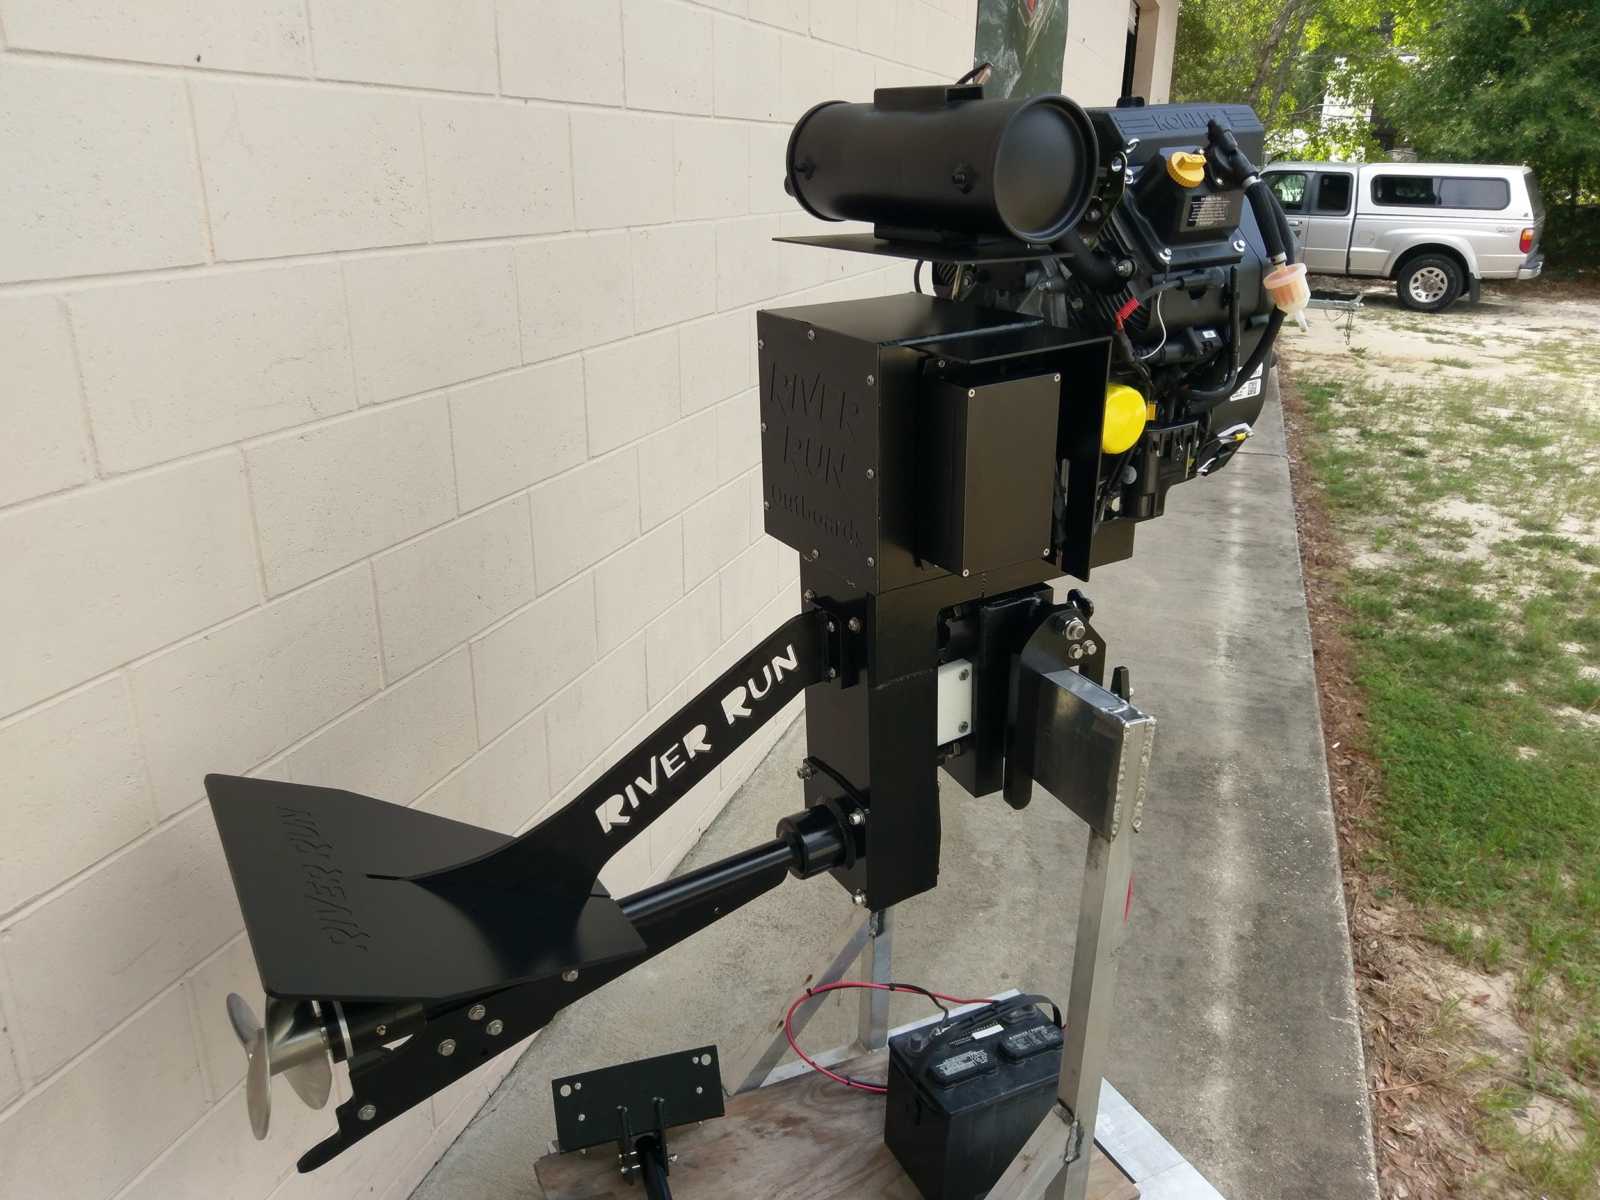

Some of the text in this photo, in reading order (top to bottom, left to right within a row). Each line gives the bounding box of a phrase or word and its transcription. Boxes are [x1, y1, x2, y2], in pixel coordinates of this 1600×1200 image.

[782, 424, 846, 490] RUN
[595, 643, 799, 834] RIVER RUN
